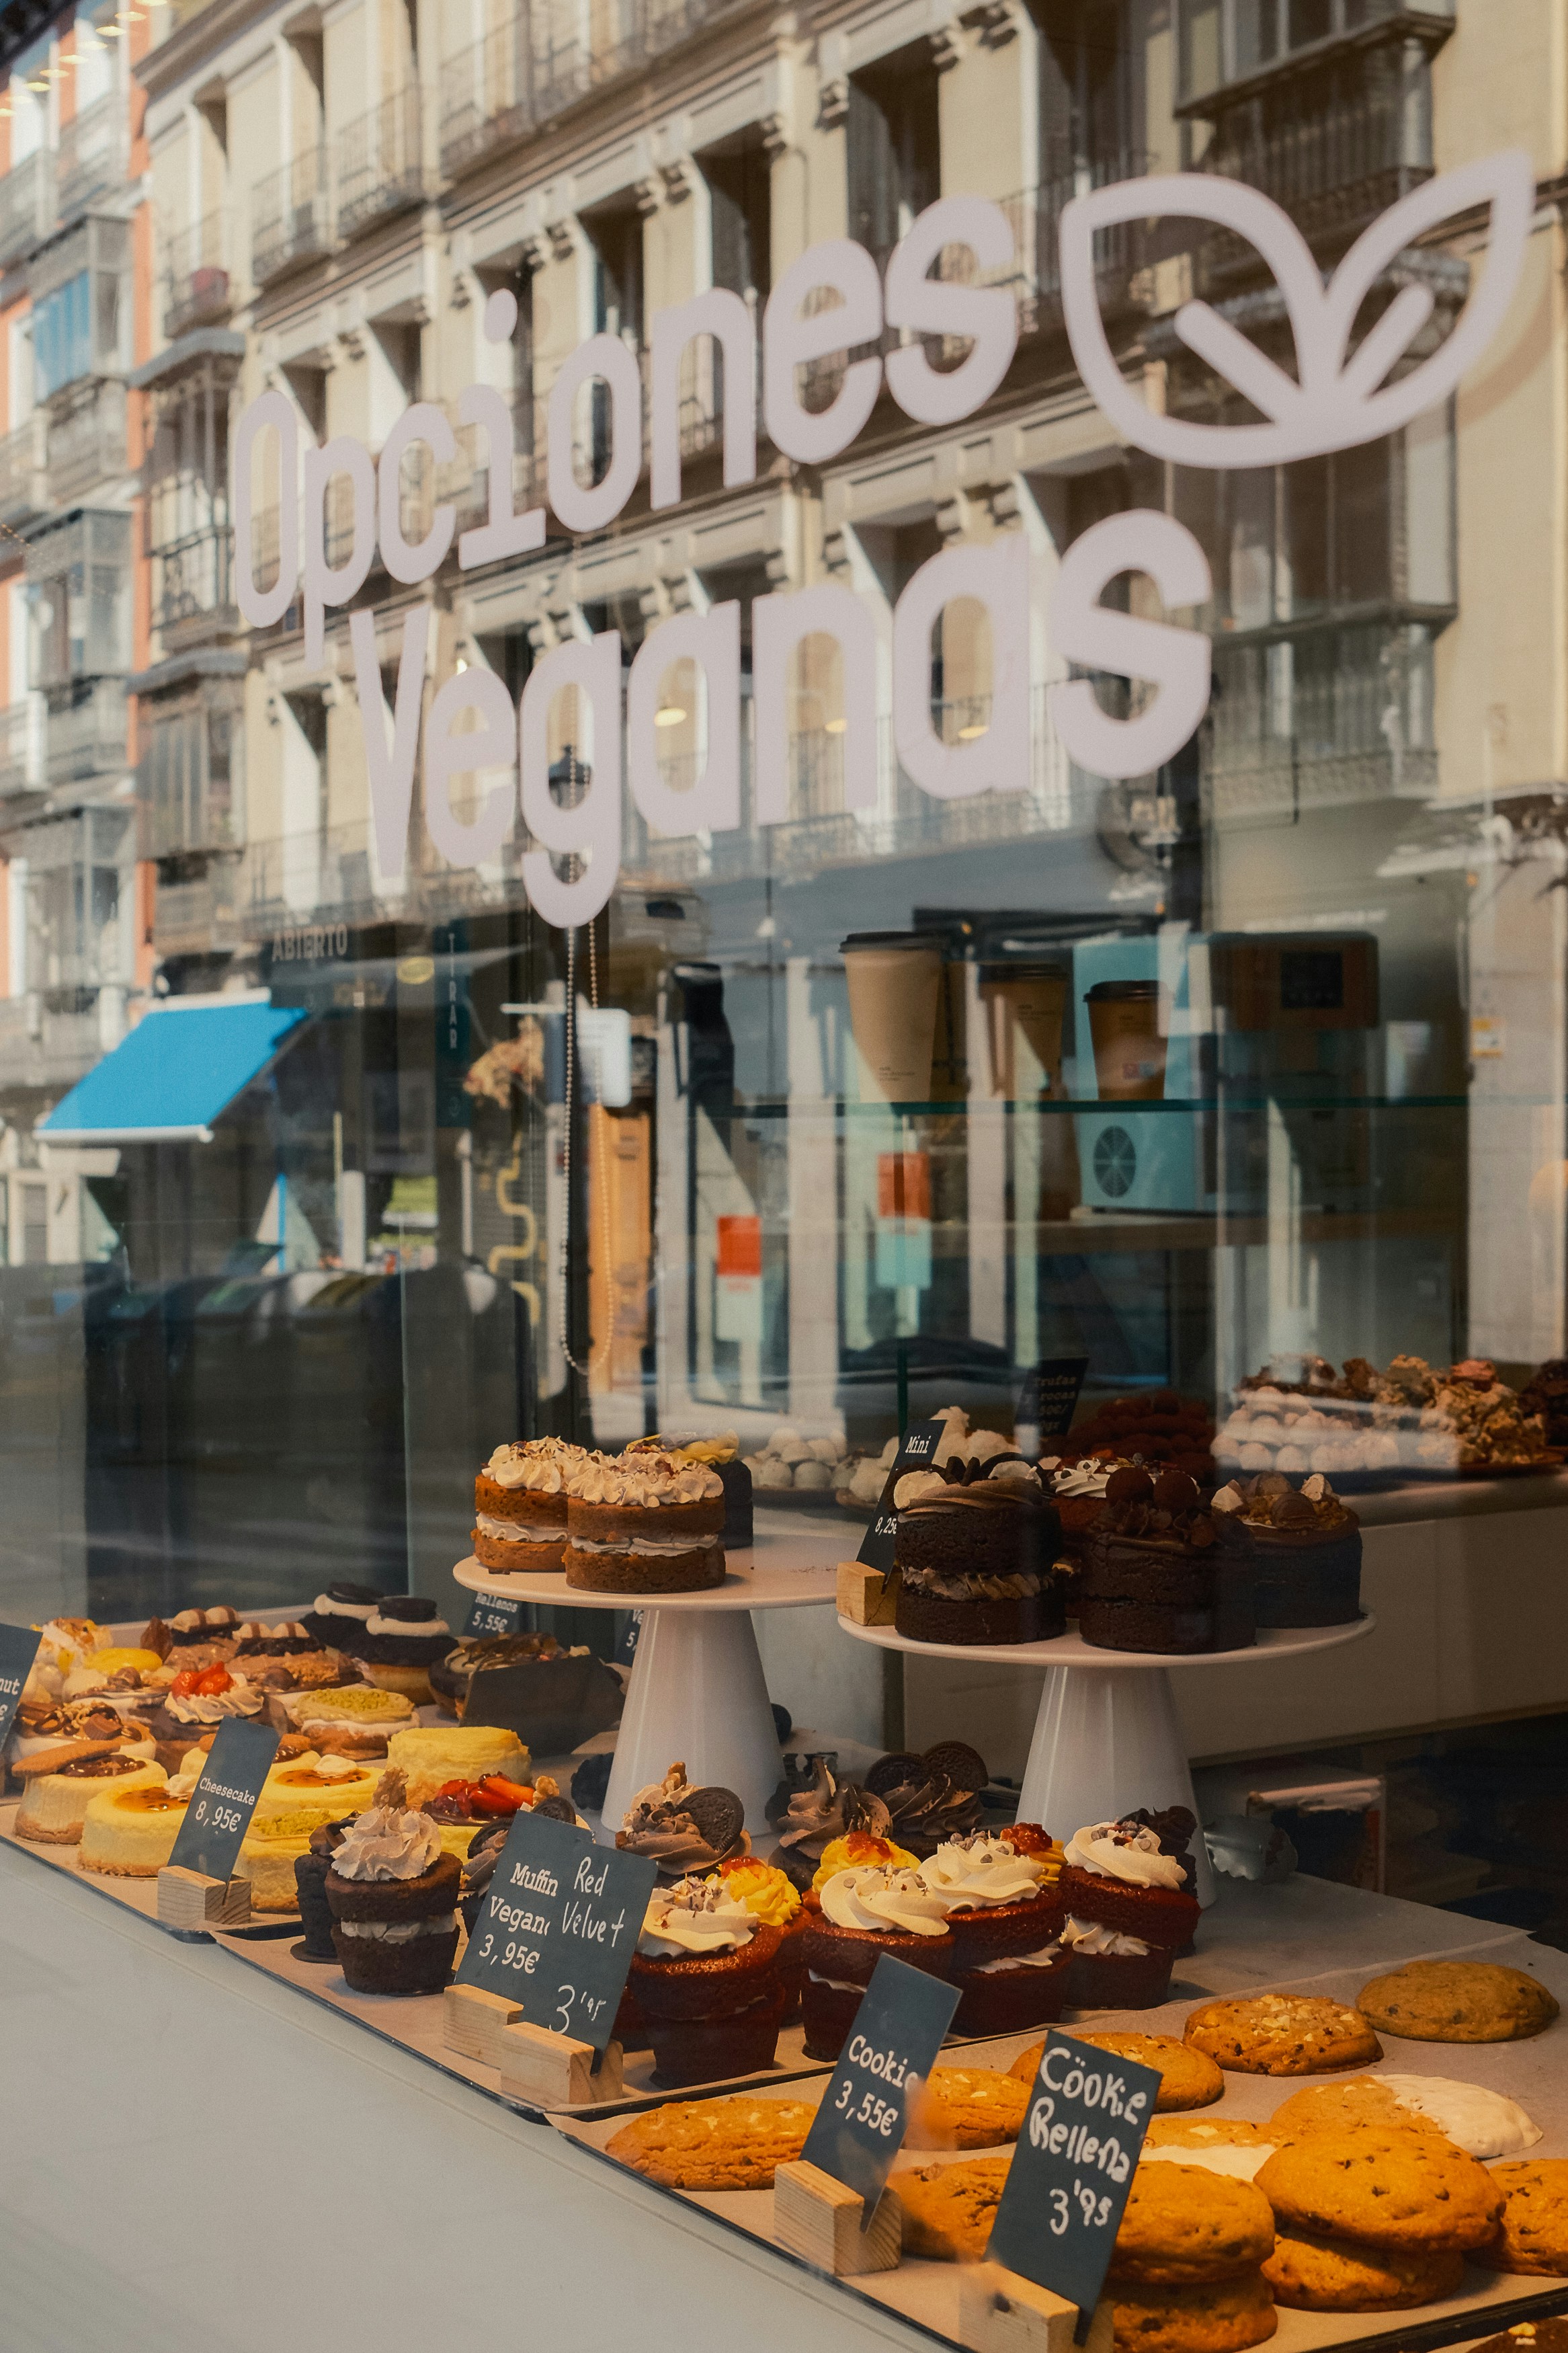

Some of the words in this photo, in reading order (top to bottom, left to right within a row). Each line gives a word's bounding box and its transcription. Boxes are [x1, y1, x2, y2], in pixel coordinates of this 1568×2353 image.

[235, 195, 1018, 672] Opciones
[349, 508, 1211, 928] Veganas
[272, 923, 348, 962] ABIERTO
[448, 932, 458, 1049] TIRAR
[905, 1435, 932, 1454] Mini
[472, 1611, 508, 1633] 5,55€
[474, 1592, 518, 1613] Rellenos
[199, 1777, 256, 1806] Cheesecake
[195, 1800, 242, 1832] 8,95€
[509, 1862, 559, 1897] Muffin
[573, 1856, 609, 1897] Red
[562, 1900, 626, 1948] Velvet
[479, 1933, 541, 1975] 3,95€
[834, 2079, 899, 2137] 3,55€
[1029, 2096, 1130, 2184] Rellena
[1048, 2178, 1113, 2236] 3'95
